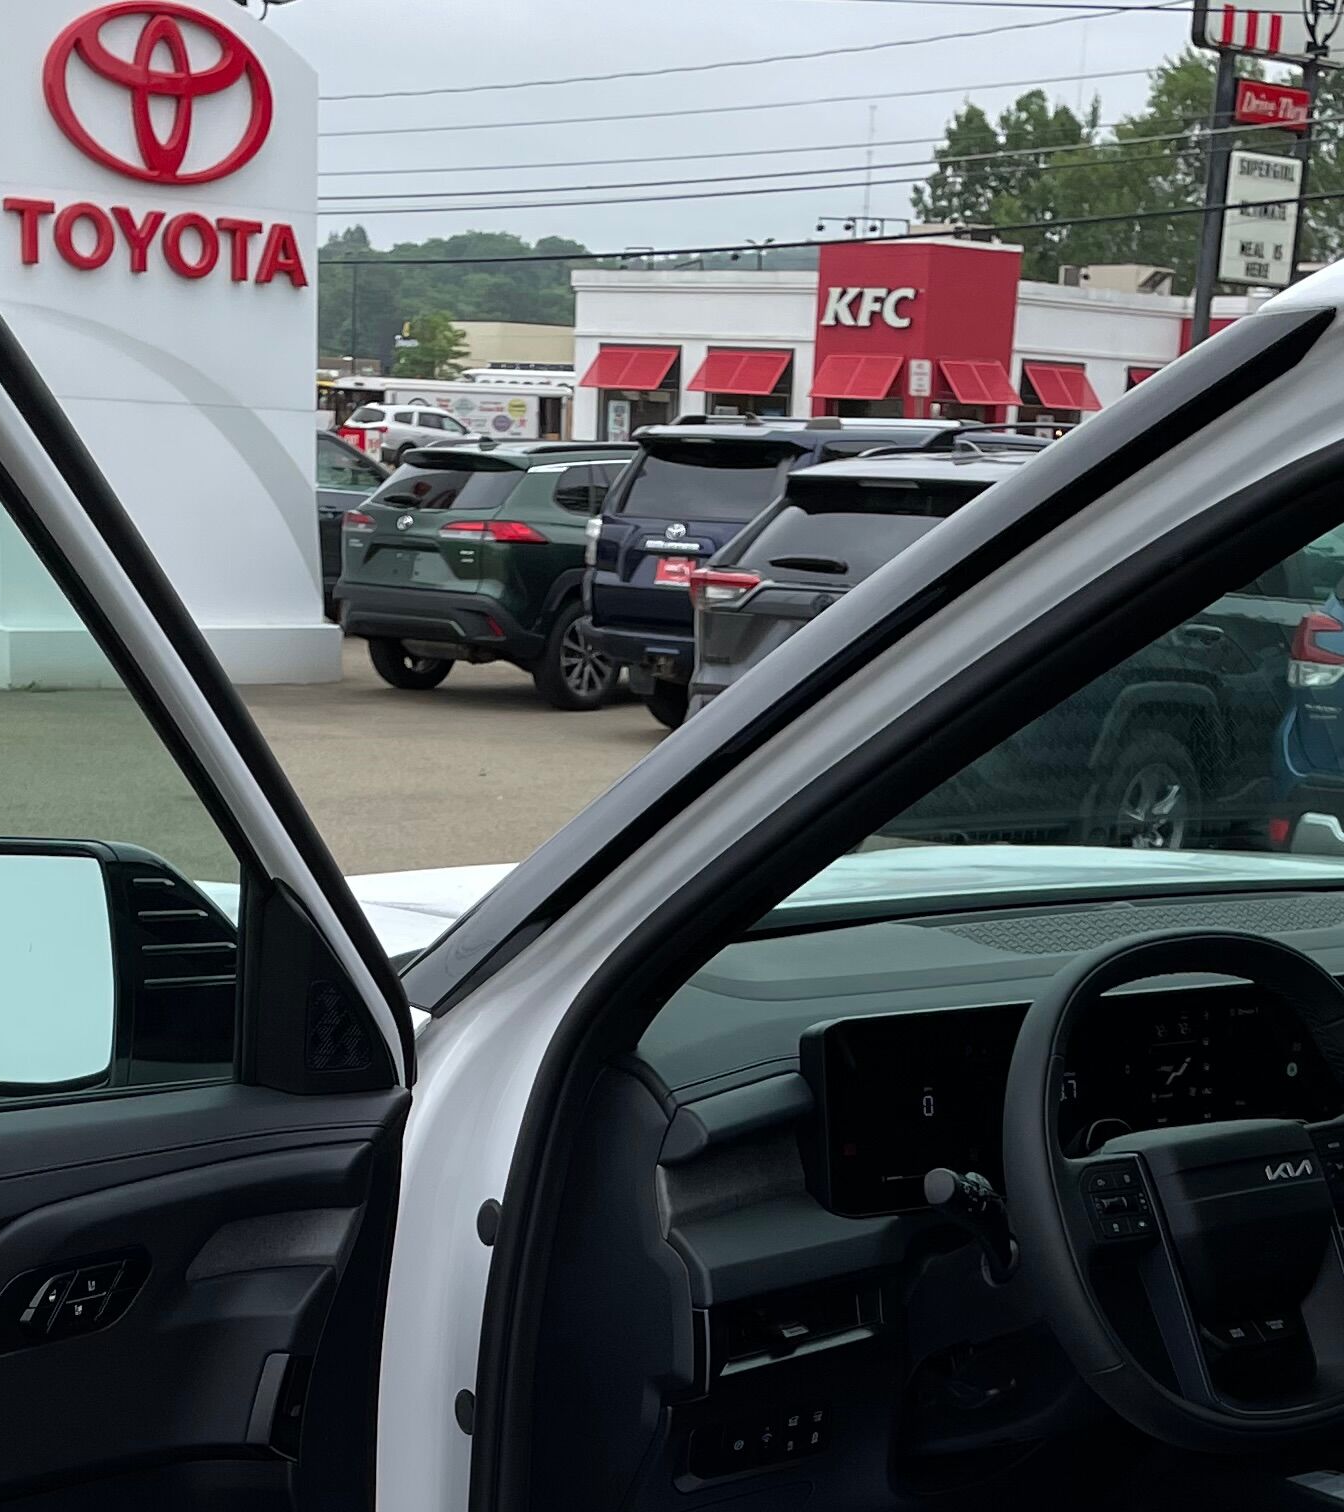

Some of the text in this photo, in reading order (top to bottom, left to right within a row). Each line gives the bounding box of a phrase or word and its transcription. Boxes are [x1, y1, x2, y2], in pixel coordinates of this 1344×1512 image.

[1242, 91, 1277, 117] Drive
[3, 197, 308, 288] TOYOTA
[820, 287, 916, 328] KFC
